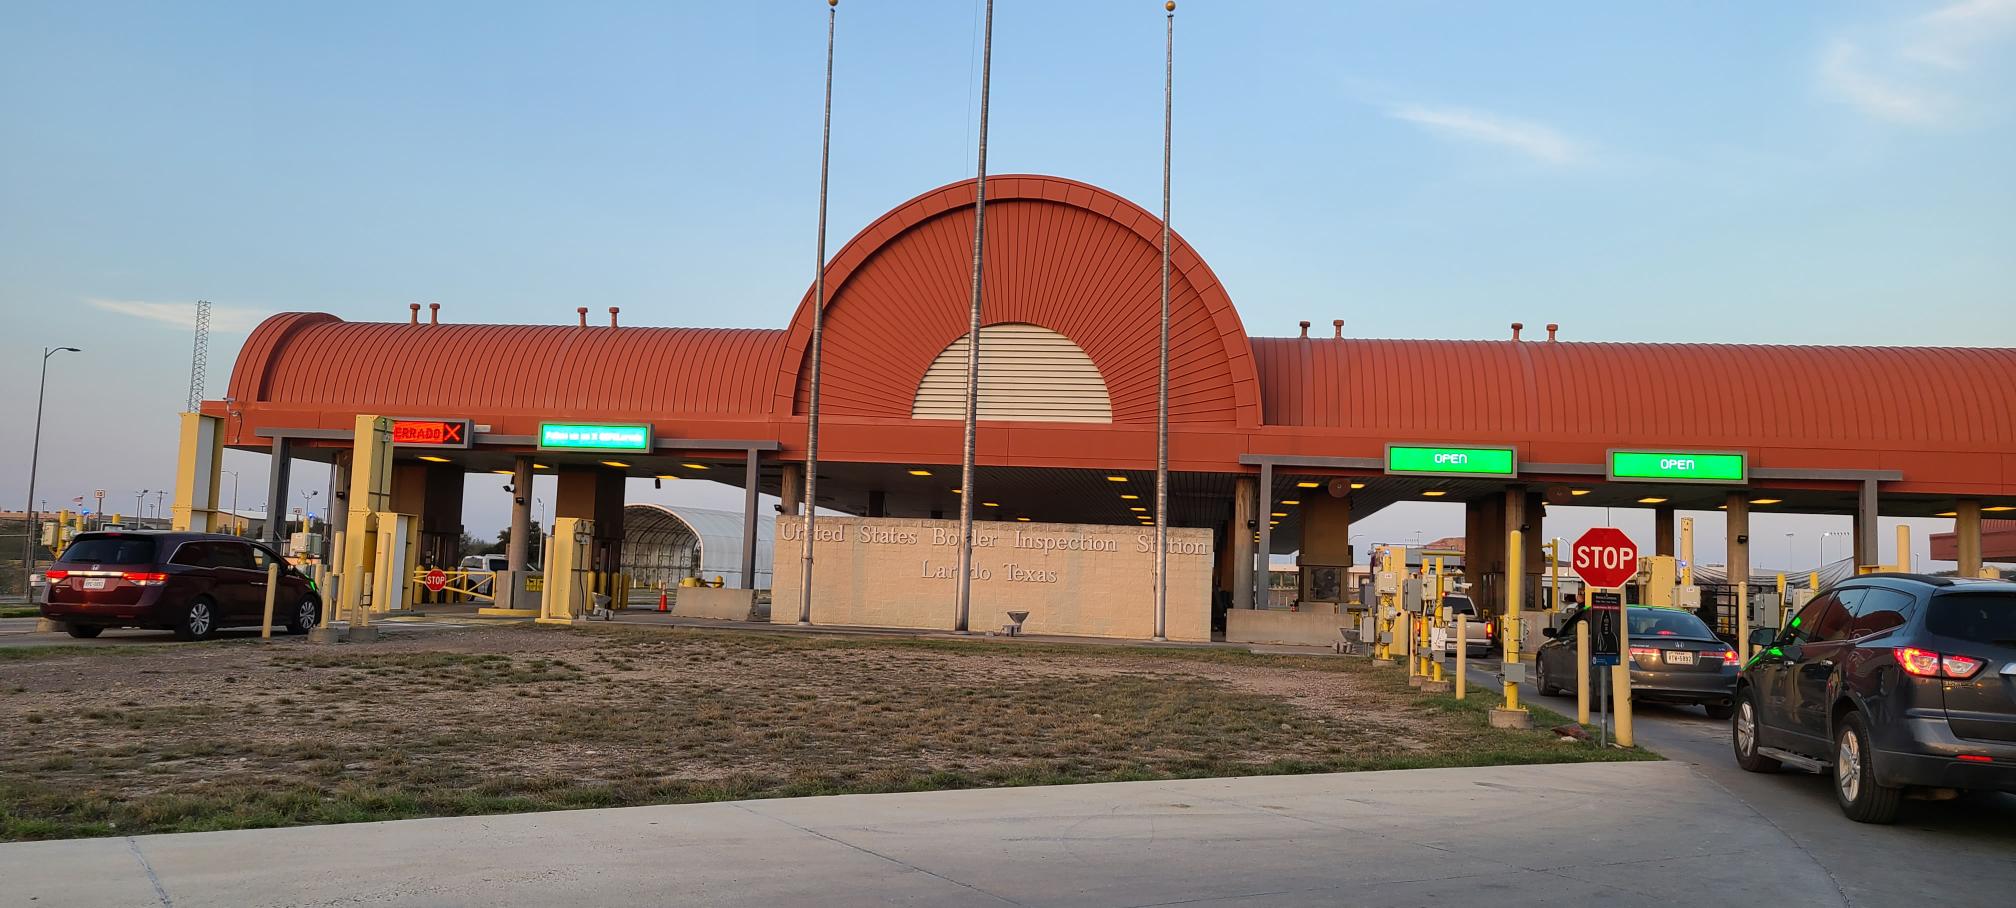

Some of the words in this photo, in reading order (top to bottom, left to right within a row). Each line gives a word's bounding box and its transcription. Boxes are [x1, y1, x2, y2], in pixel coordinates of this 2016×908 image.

[394, 427, 441, 440] ERRADO
[1434, 453, 1468, 464] OPEN
[1660, 458, 1695, 470] OPEN
[780, 522, 845, 542] Unted
[859, 525, 918, 545] States
[932, 527, 998, 547] Boder
[1013, 530, 1117, 555] Inspection
[1136, 534, 1207, 555] Sttion
[1576, 545, 1634, 570] STOP
[921, 559, 992, 580] Lardo
[1003, 563, 1057, 583] Texas
[426, 576, 445, 585] STOP
